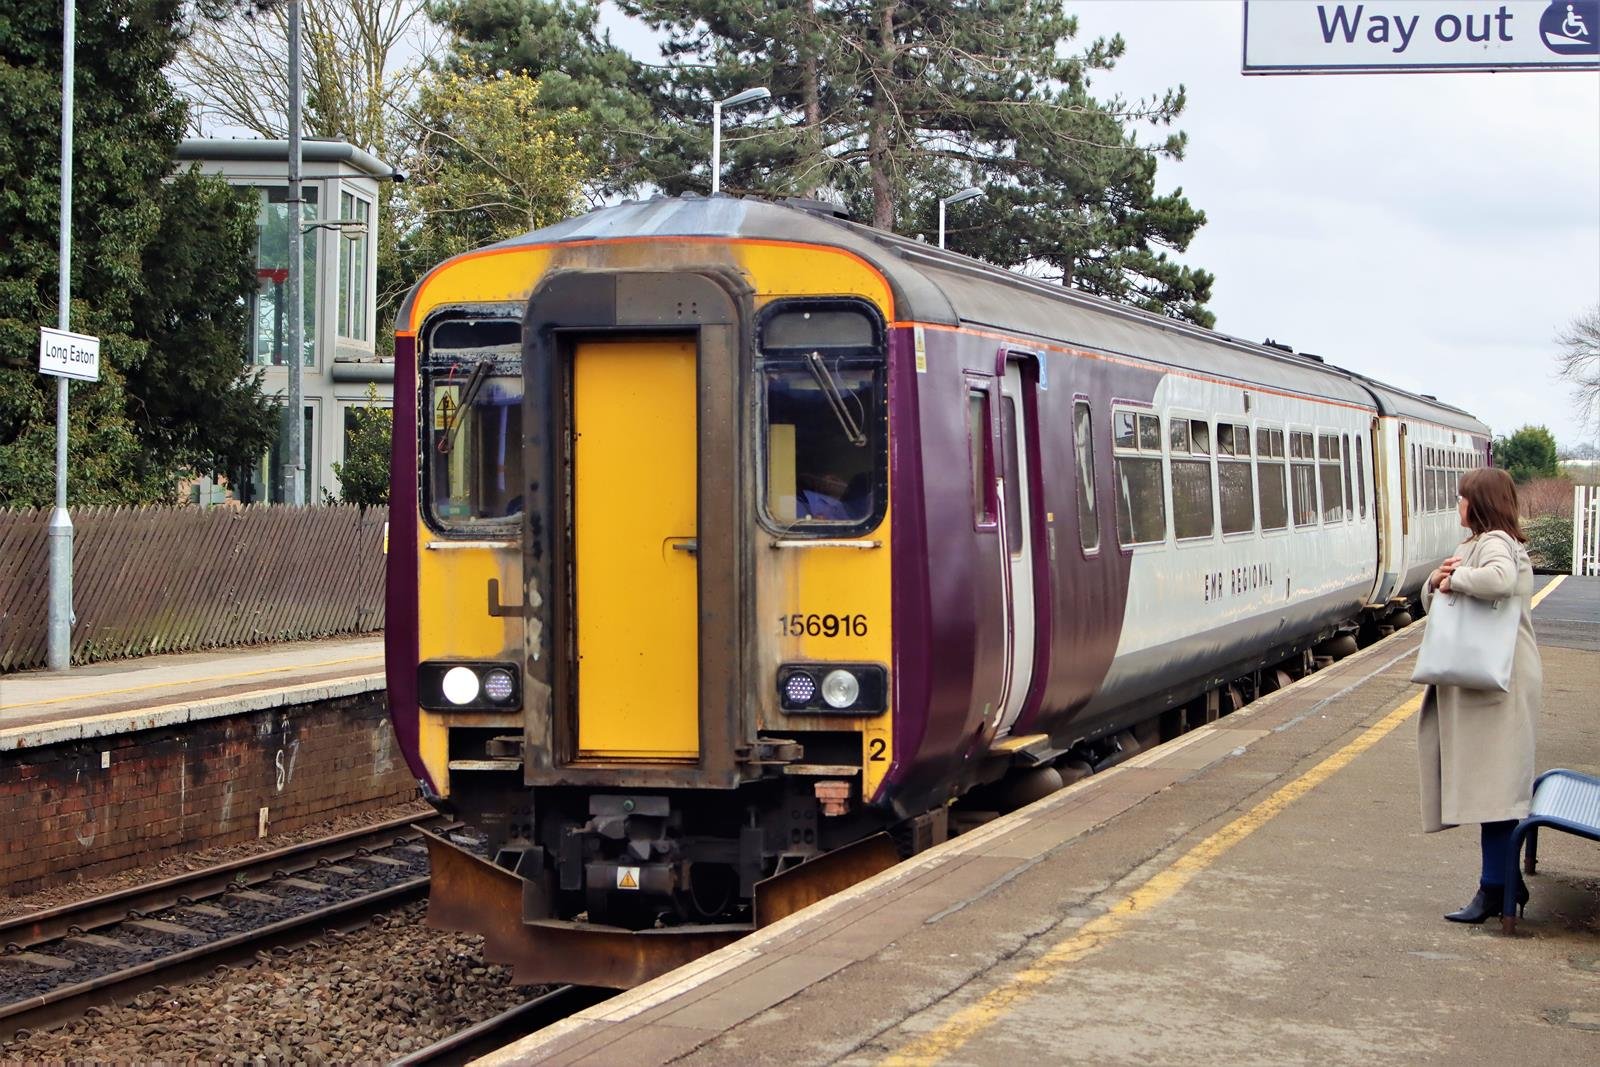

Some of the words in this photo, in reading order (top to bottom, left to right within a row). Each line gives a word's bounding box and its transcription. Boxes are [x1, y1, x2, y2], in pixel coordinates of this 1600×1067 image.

[1317, 4, 1420, 53] Way
[1434, 6, 1514, 42] out
[46, 340, 68, 364] Long
[70, 344, 95, 365] Eaton
[1205, 571, 1223, 602] EMR
[1231, 561, 1273, 596] REGIONAL
[779, 613, 868, 638] 156916
[869, 738, 887, 762] 2
